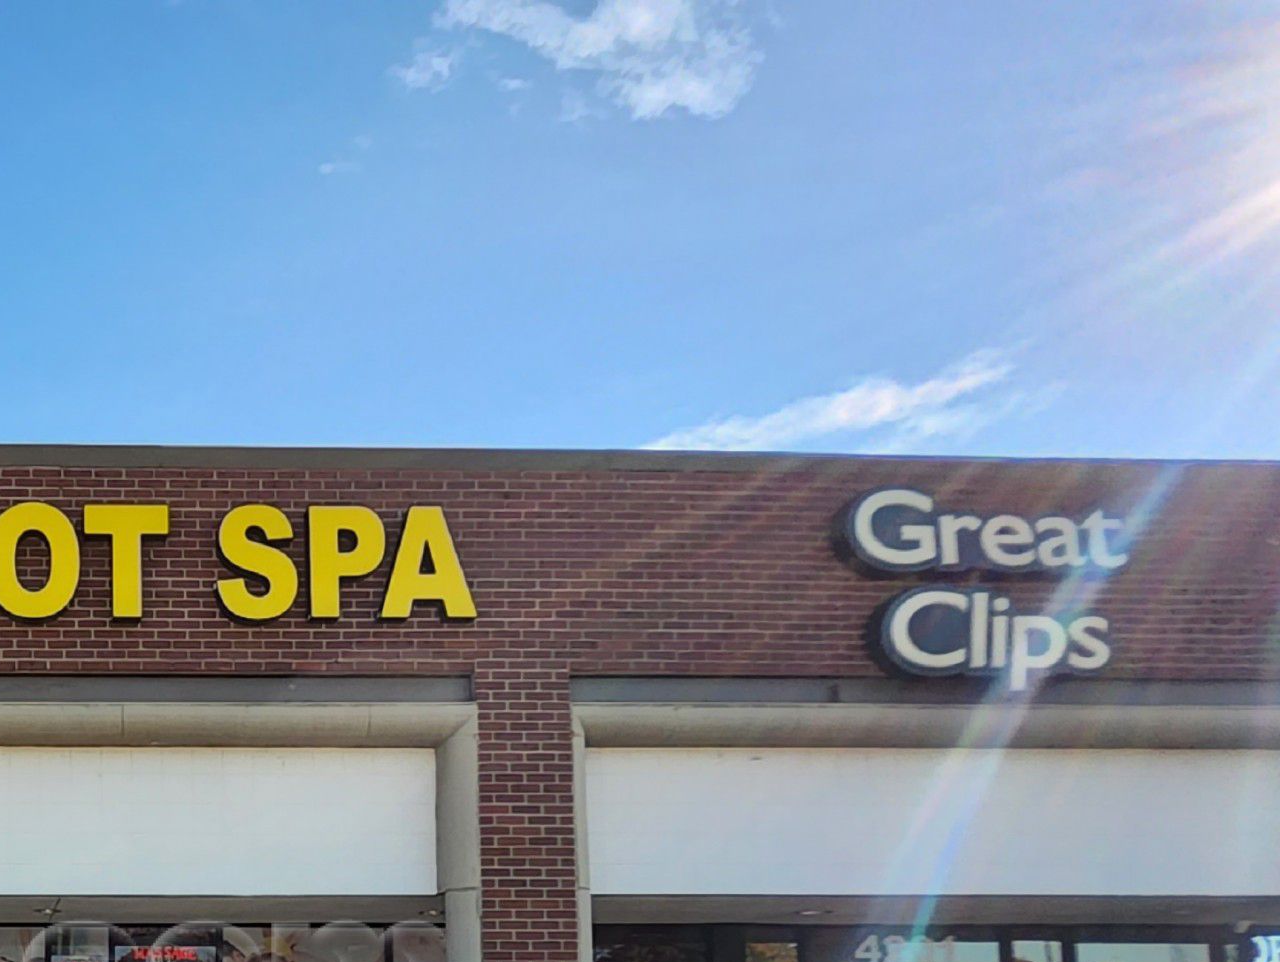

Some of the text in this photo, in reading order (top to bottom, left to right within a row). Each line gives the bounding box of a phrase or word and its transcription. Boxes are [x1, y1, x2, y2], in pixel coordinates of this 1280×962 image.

[215, 504, 478, 621] SPA
[854, 489, 1128, 569] Great
[889, 591, 1111, 691] Clips
